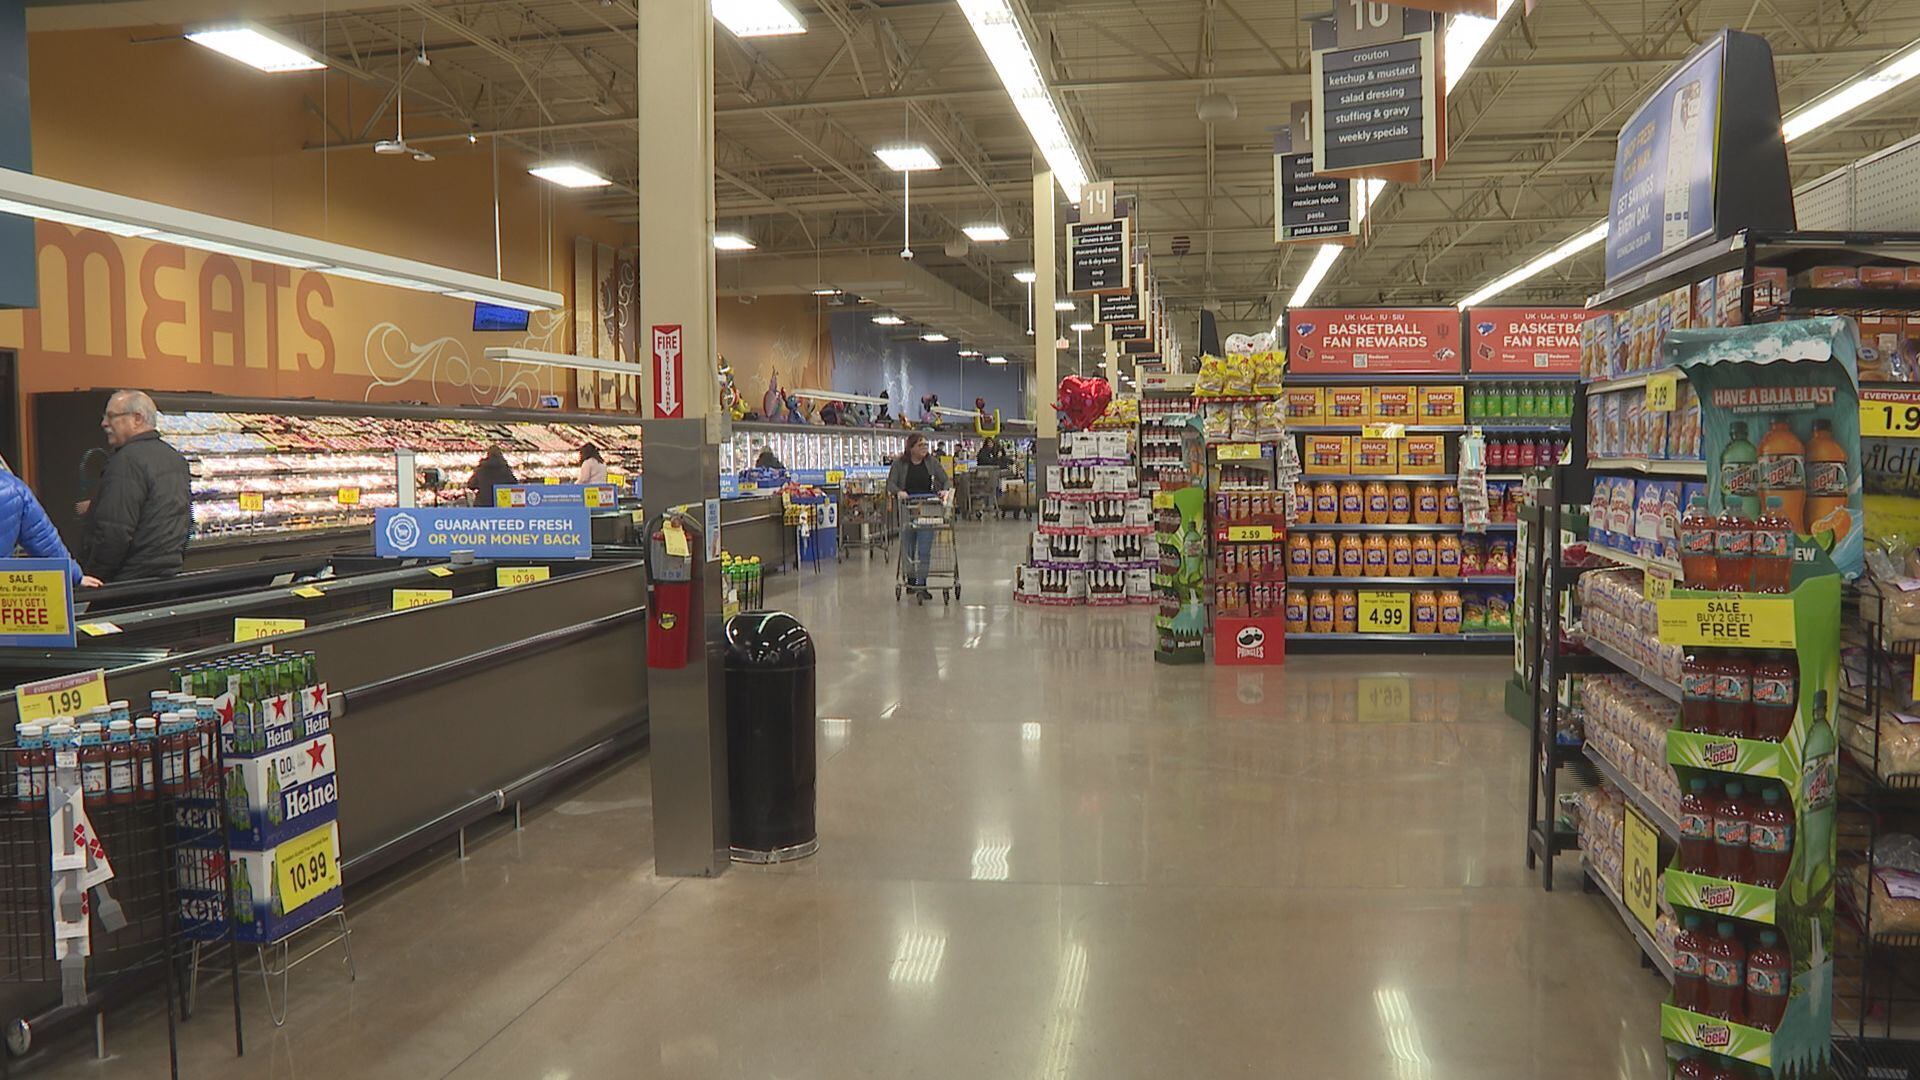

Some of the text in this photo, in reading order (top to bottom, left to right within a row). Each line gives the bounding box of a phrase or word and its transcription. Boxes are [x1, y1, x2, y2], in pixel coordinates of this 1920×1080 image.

[1350, 0, 1389, 31] 10
[1353, 49, 1389, 63] crouton
[1329, 65, 1415, 86] ketchup & mustard
[1340, 86, 1405, 104] salad dressing
[1335, 105, 1410, 124] stuffing & gravy
[1338, 125, 1409, 143] weekly specials
[1295, 181, 1337, 193] kosher foods
[1086, 189, 1107, 214] 14
[1292, 196, 1339, 207] mexican foods
[1306, 211, 1325, 221] pasta
[1294, 226, 1312, 236] pasta
[1319, 224, 1338, 232] sauce
[22, 217, 338, 374] MEATS
[1328, 323, 1421, 335] BASKETBALL
[657, 335, 678, 350] FIRE
[1322, 336, 1428, 348] FAN REWARDS
[1503, 335, 1532, 347] FAN
[1336, 394, 1361, 402] SNACK
[1381, 393, 1407, 401] SNACK
[1714, 386, 1836, 405] HAVE A BAJA BLAST
[1864, 391, 1911, 401] EVERYDAY
[434, 519, 573, 531] GUARANTEED FRESH
[428, 534, 581, 545] OR YOUR MONEY BACK
[1241, 530, 1260, 539] 2.59
[8, 574, 34, 583] SALE
[1, 598, 18, 608] BUY
[25, 598, 40, 608] GET
[1707, 602, 1741, 613] SALE
[1, 608, 49, 625] FREE
[1369, 607, 1403, 625] 4.99
[1696, 613, 1717, 622] BUY
[1718, 613, 1725, 622] 2
[1726, 613, 1747, 622] GET
[1700, 622, 1751, 638] FREE
[1236, 646, 1264, 659] PRINGLES
[47, 689, 82, 715] 1.99
[305, 715, 330, 736] Hein
[265, 727, 294, 749] Hein
[289, 851, 327, 893] 10.99
